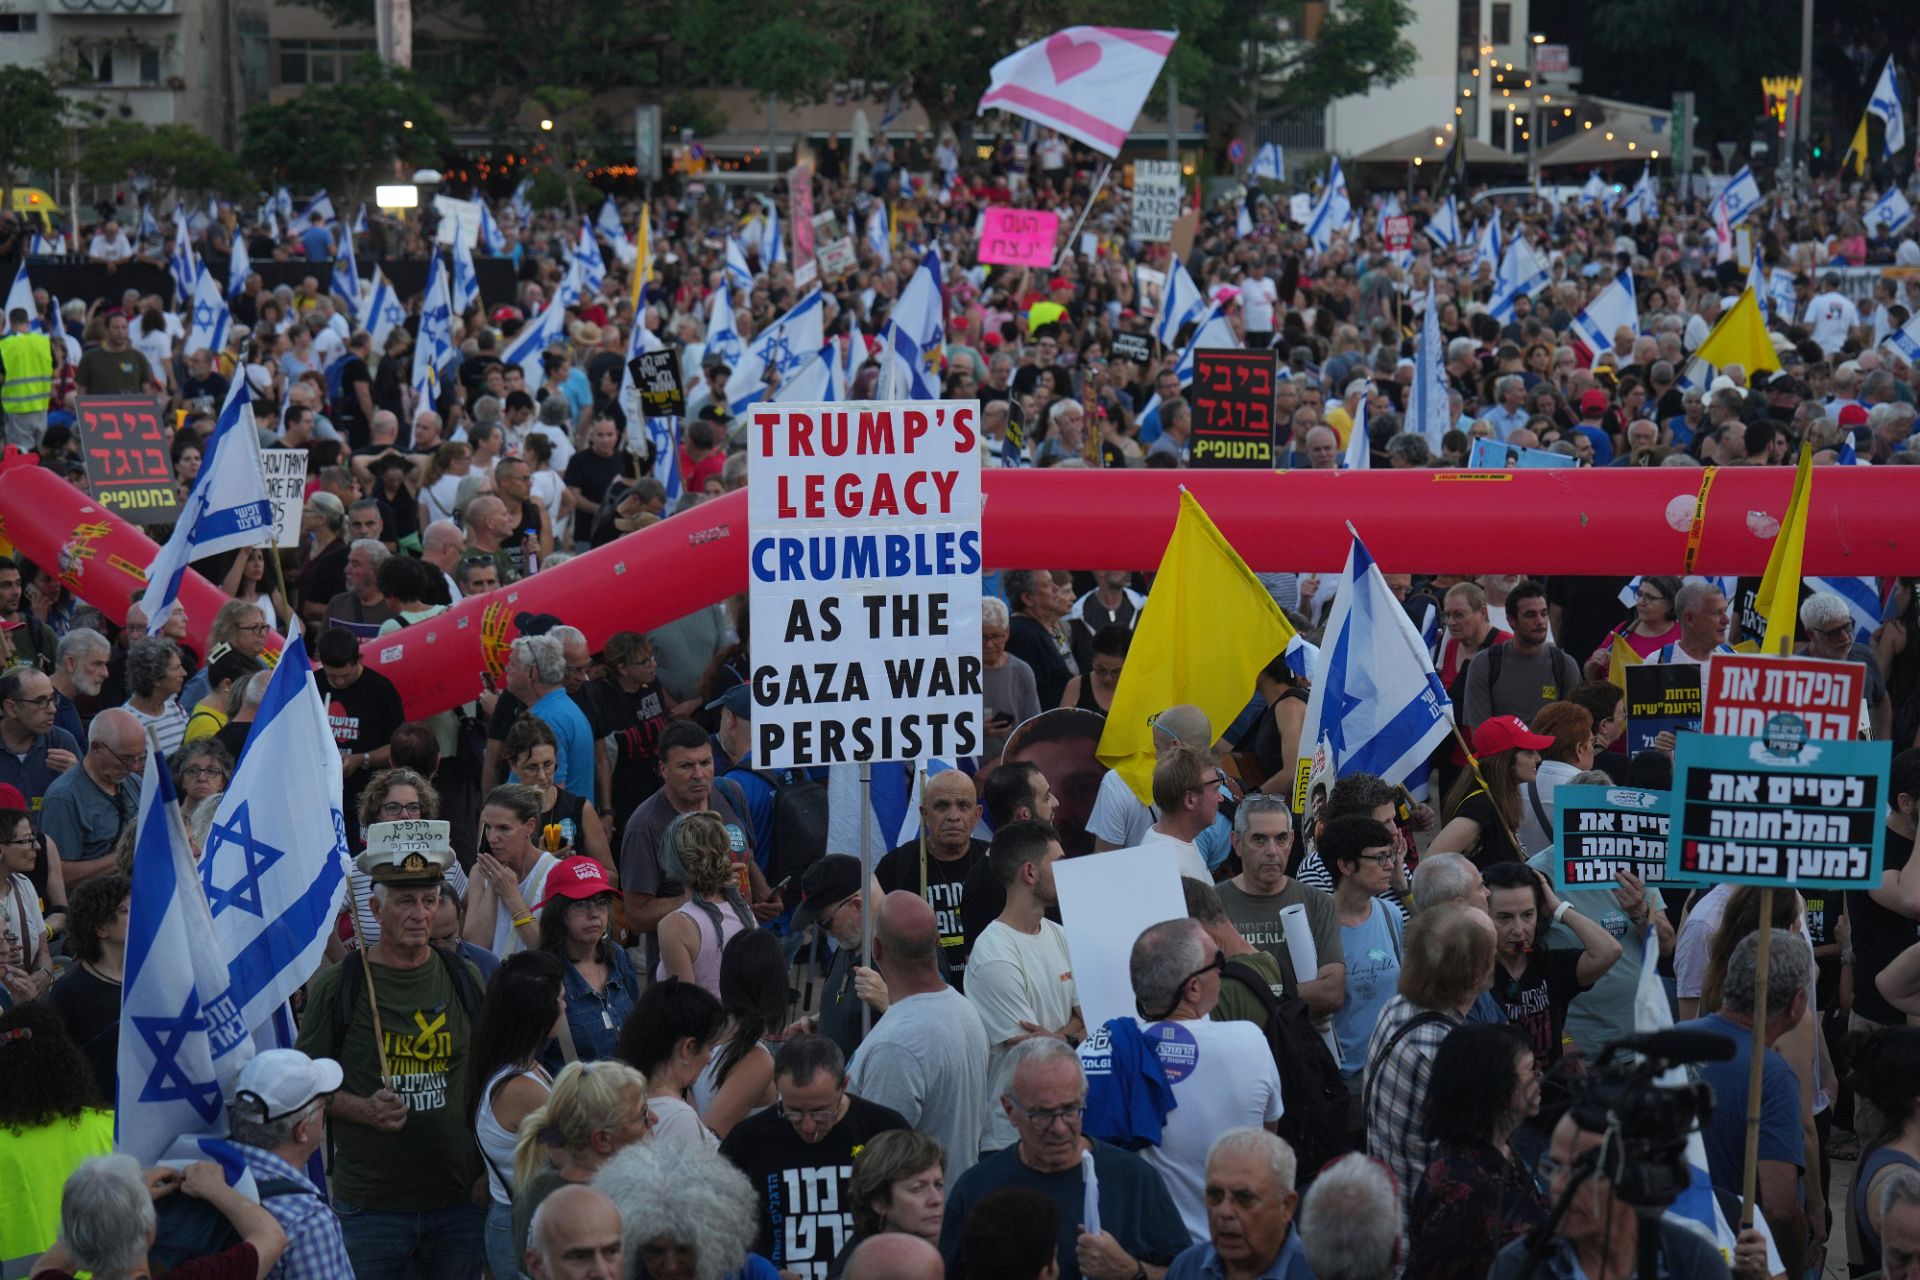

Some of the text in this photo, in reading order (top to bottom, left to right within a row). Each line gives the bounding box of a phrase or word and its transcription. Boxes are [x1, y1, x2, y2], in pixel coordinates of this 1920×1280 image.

[1001, 214, 1039, 234] העם
[992, 240, 1041, 258] ינצח
[1199, 362, 1271, 395] ביבי
[84, 411, 161, 441] ביבי
[1197, 397, 1269, 429] בוגד
[753, 408, 976, 457] TRUMP'S
[90, 448, 169, 477] בוגד
[262, 452, 309, 475] HOW MANY
[266, 477, 304, 499] ORE FOR
[777, 470, 960, 519] LEGACY
[234, 505, 260, 518] ופשי
[237, 515, 262, 530] ארצנו
[751, 530, 981, 582] CRUMBLES
[784, 592, 949, 643] AS THE
[752, 655, 983, 707] GAZA WAR
[1665, 688, 1700, 700] הדחת
[1719, 665, 1852, 708] הפקרת את
[760, 711, 976, 767] PERSISTS
[1708, 773, 1865, 808] לסיים את
[1579, 812, 1670, 836] סיים את
[1709, 809, 1851, 844] המלחמה
[1581, 836, 1668, 859] מלחמה
[1685, 839, 1868, 883] למען כולנו!
